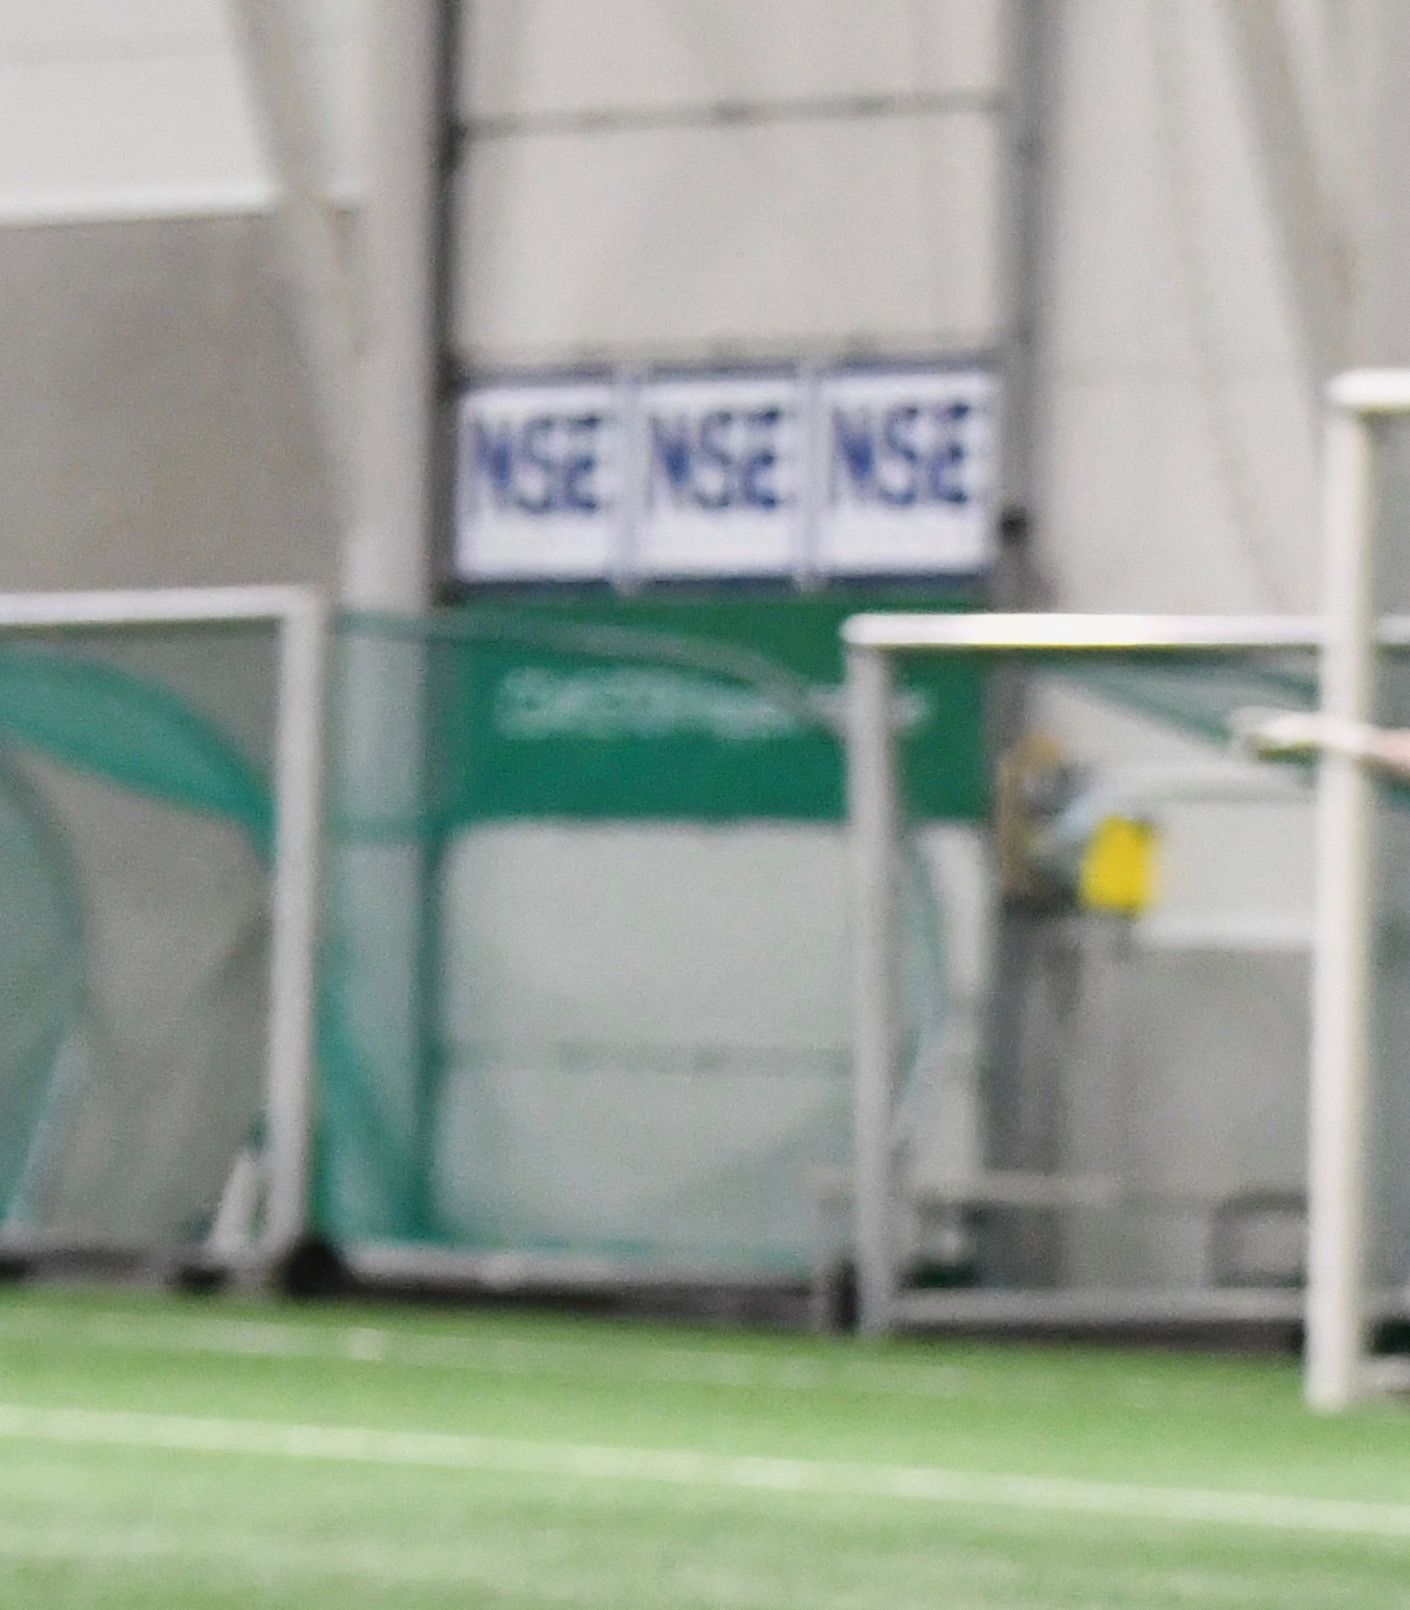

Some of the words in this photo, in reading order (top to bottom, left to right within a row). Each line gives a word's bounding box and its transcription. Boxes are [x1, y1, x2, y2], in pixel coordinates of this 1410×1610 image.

[472, 412, 602, 516] NSE
[648, 406, 780, 512] NSE
[830, 402, 972, 508] NSE
